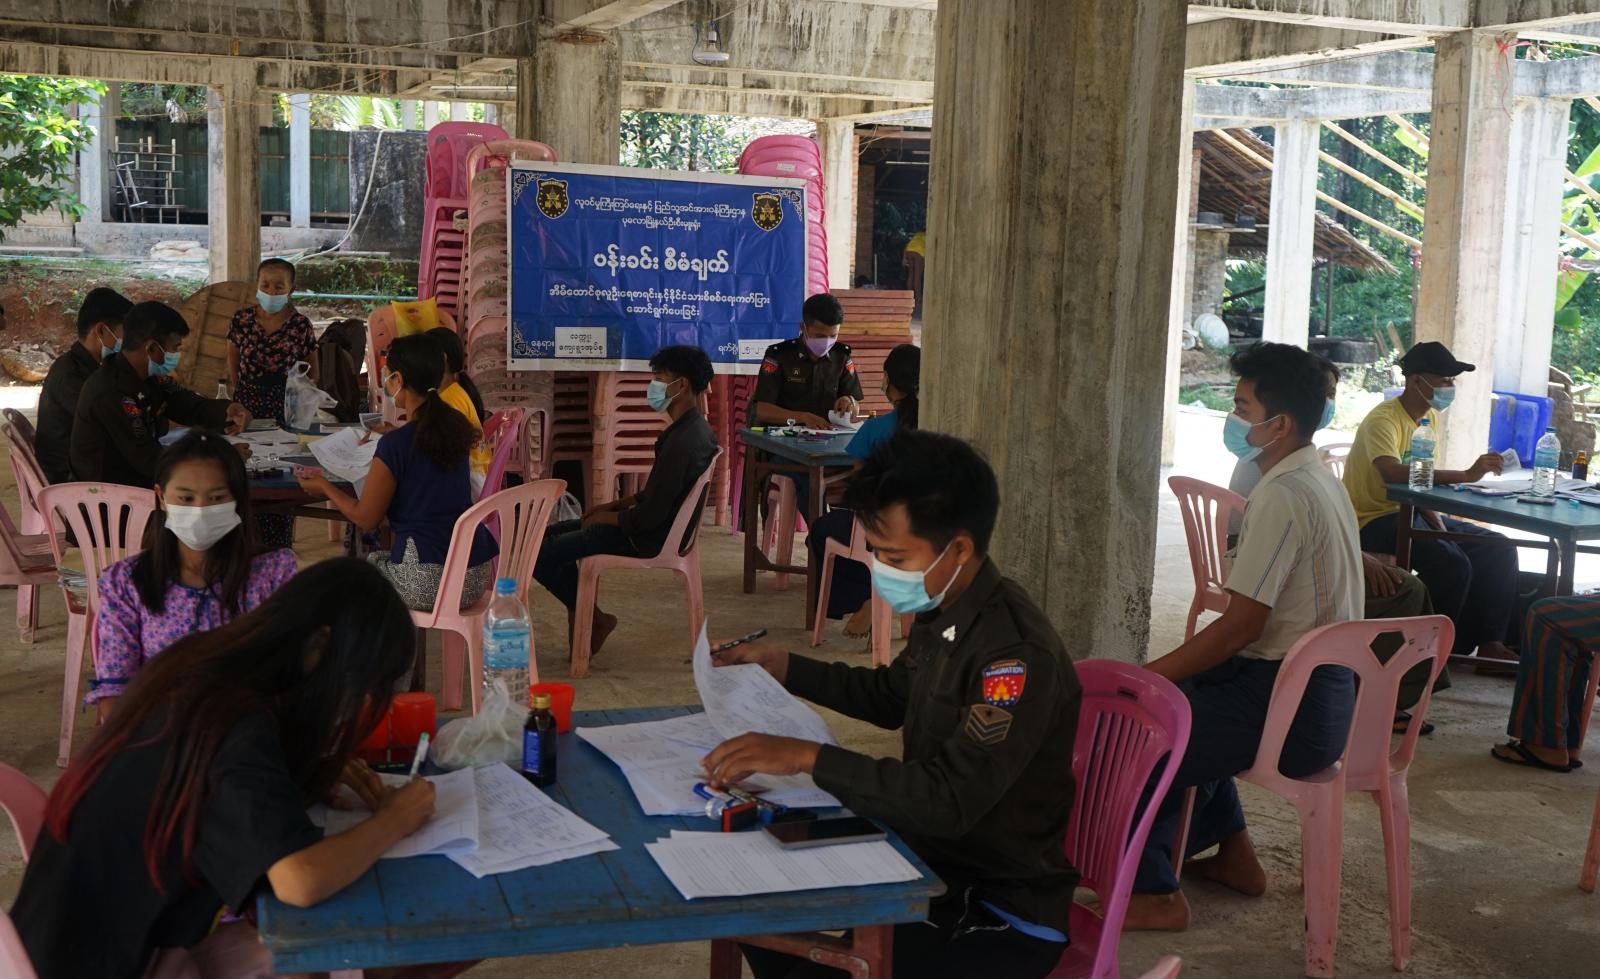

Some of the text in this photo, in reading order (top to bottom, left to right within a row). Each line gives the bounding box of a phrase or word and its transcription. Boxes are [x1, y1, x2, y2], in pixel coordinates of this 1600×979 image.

[593, 243, 729, 281] ပန်းခင်း စီမံချက်
[626, 303, 700, 320] ဆောင်ရွက်ပေးခြင်း
